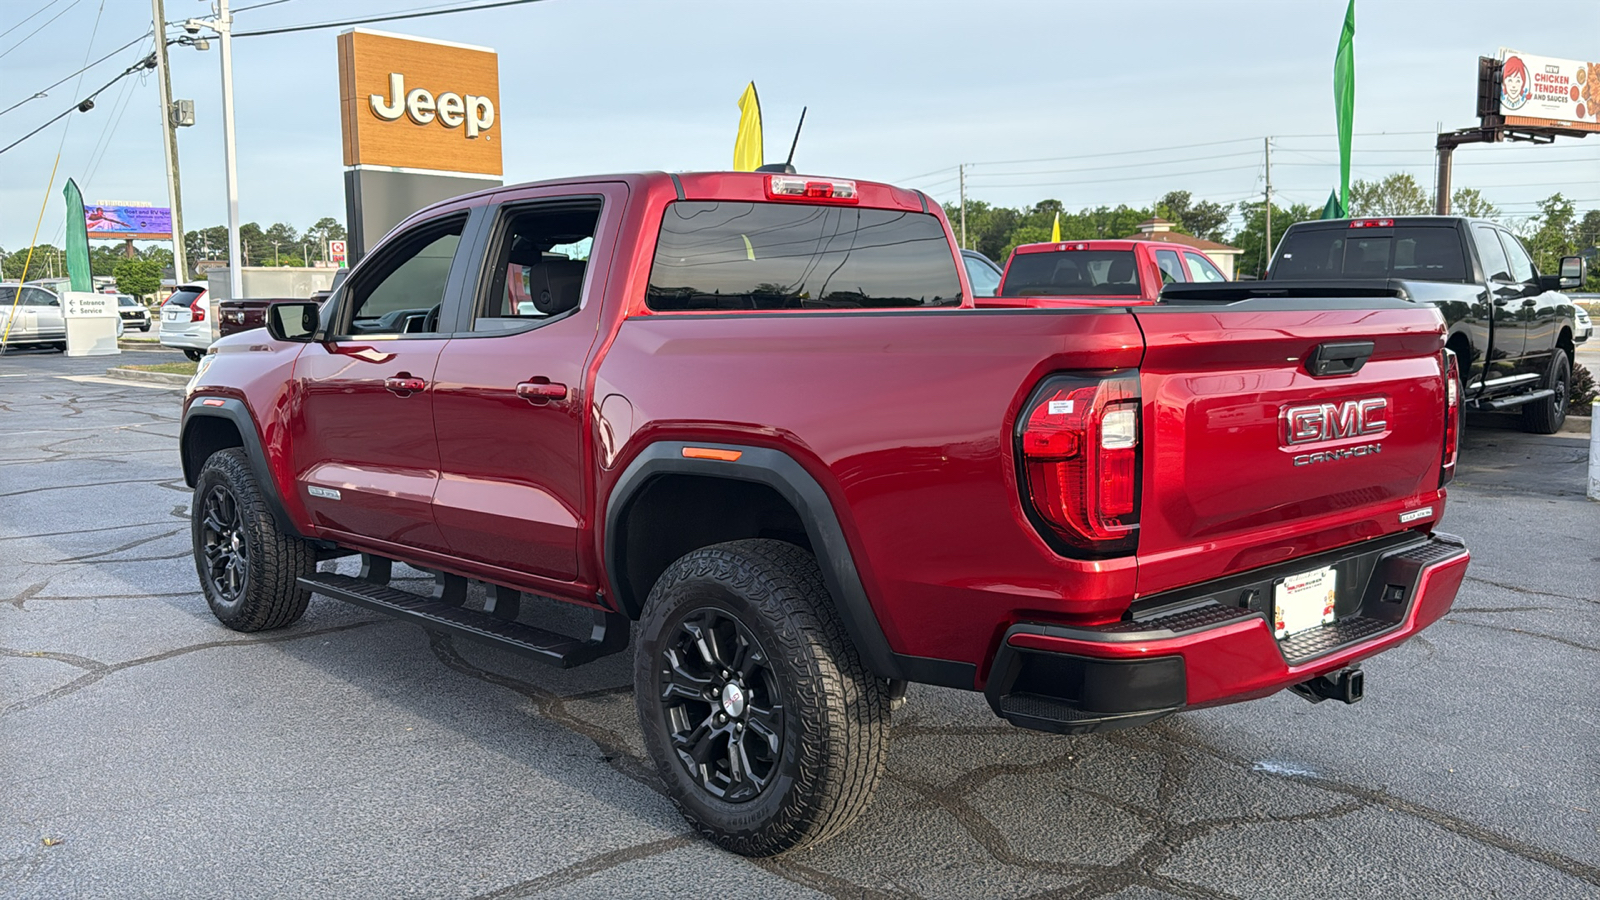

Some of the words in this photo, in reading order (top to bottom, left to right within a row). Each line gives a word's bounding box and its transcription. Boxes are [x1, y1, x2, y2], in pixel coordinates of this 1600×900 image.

[1534, 73, 1569, 84] CHICKEN
[1533, 93, 1546, 101] AND
[1547, 94, 1568, 103] SAUCES
[1534, 83, 1569, 95] TENDERS
[368, 72, 495, 139] Jeep
[1287, 397, 1388, 445] GMC
[1293, 443, 1382, 467] CANYON
